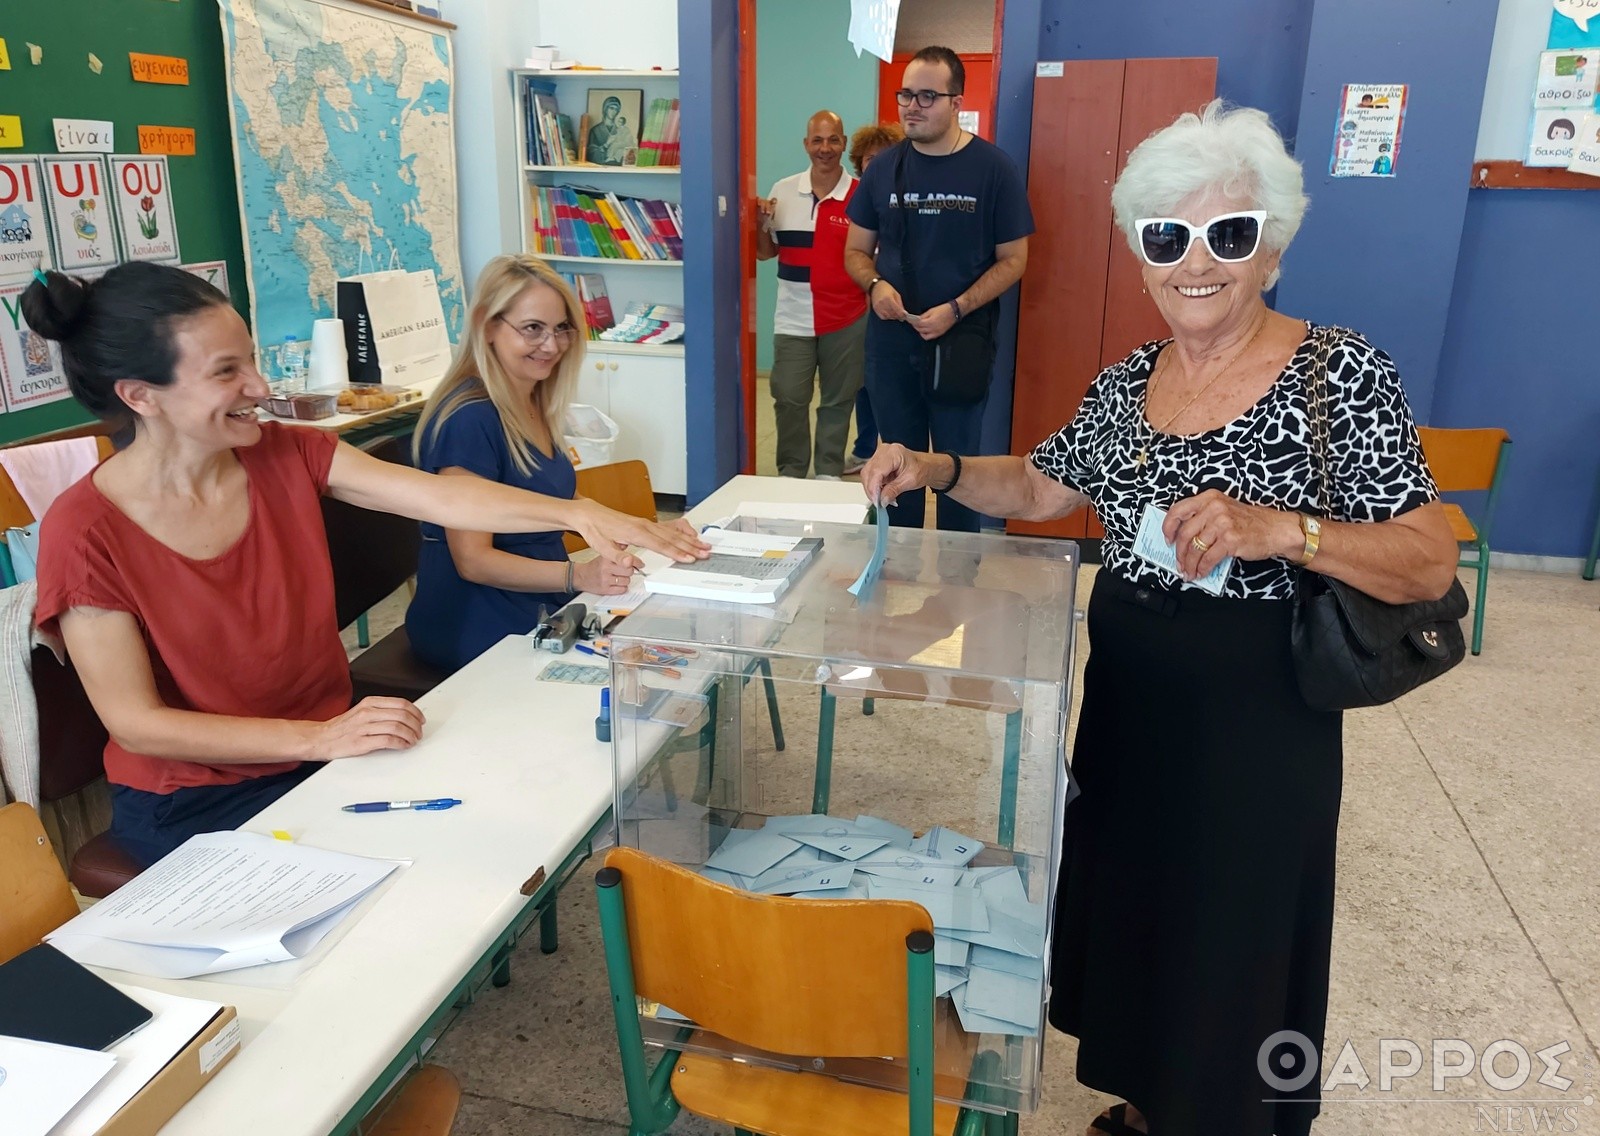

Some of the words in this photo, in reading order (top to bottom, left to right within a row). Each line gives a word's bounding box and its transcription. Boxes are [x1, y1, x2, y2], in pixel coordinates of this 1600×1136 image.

[58, 125, 110, 148] είναι
[1535, 147, 1574, 159] δακρύζ
[924, 192, 977, 213] ABOVE
[0, 249, 44, 263] ικογένεια
[77, 244, 101, 261] υιός
[380, 326, 414, 340] AMERICAN
[416, 317, 439, 331] EAGLE
[19, 373, 62, 393] άγκυρα
